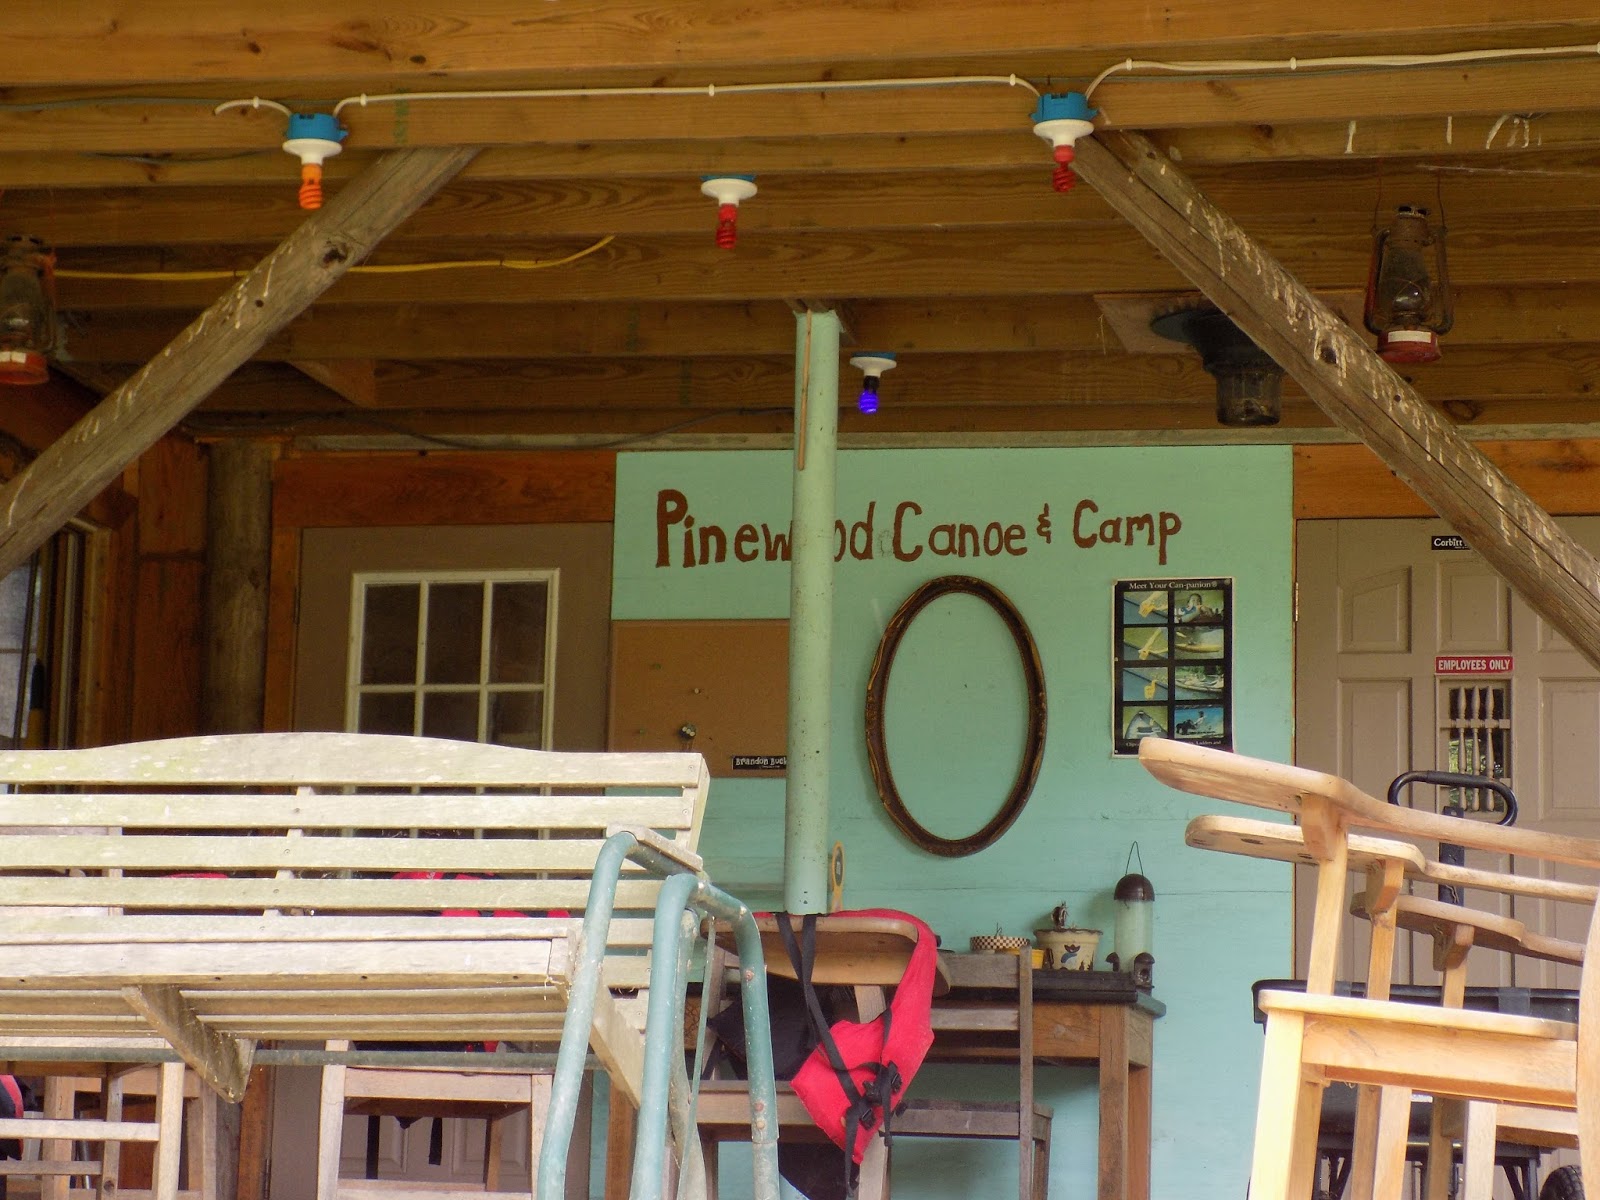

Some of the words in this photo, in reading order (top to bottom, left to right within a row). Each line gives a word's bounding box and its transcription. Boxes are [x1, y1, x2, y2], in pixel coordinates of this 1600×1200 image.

[655, 489, 876, 568] Pinewod
[893, 501, 1028, 562] Canoe
[1036, 502, 1052, 544] &
[1073, 499, 1182, 566] Camp
[1438, 660, 1487, 671] EMPLOYEES
[1489, 659, 1511, 670] ONLY
[735, 757, 769, 765] Brandon
